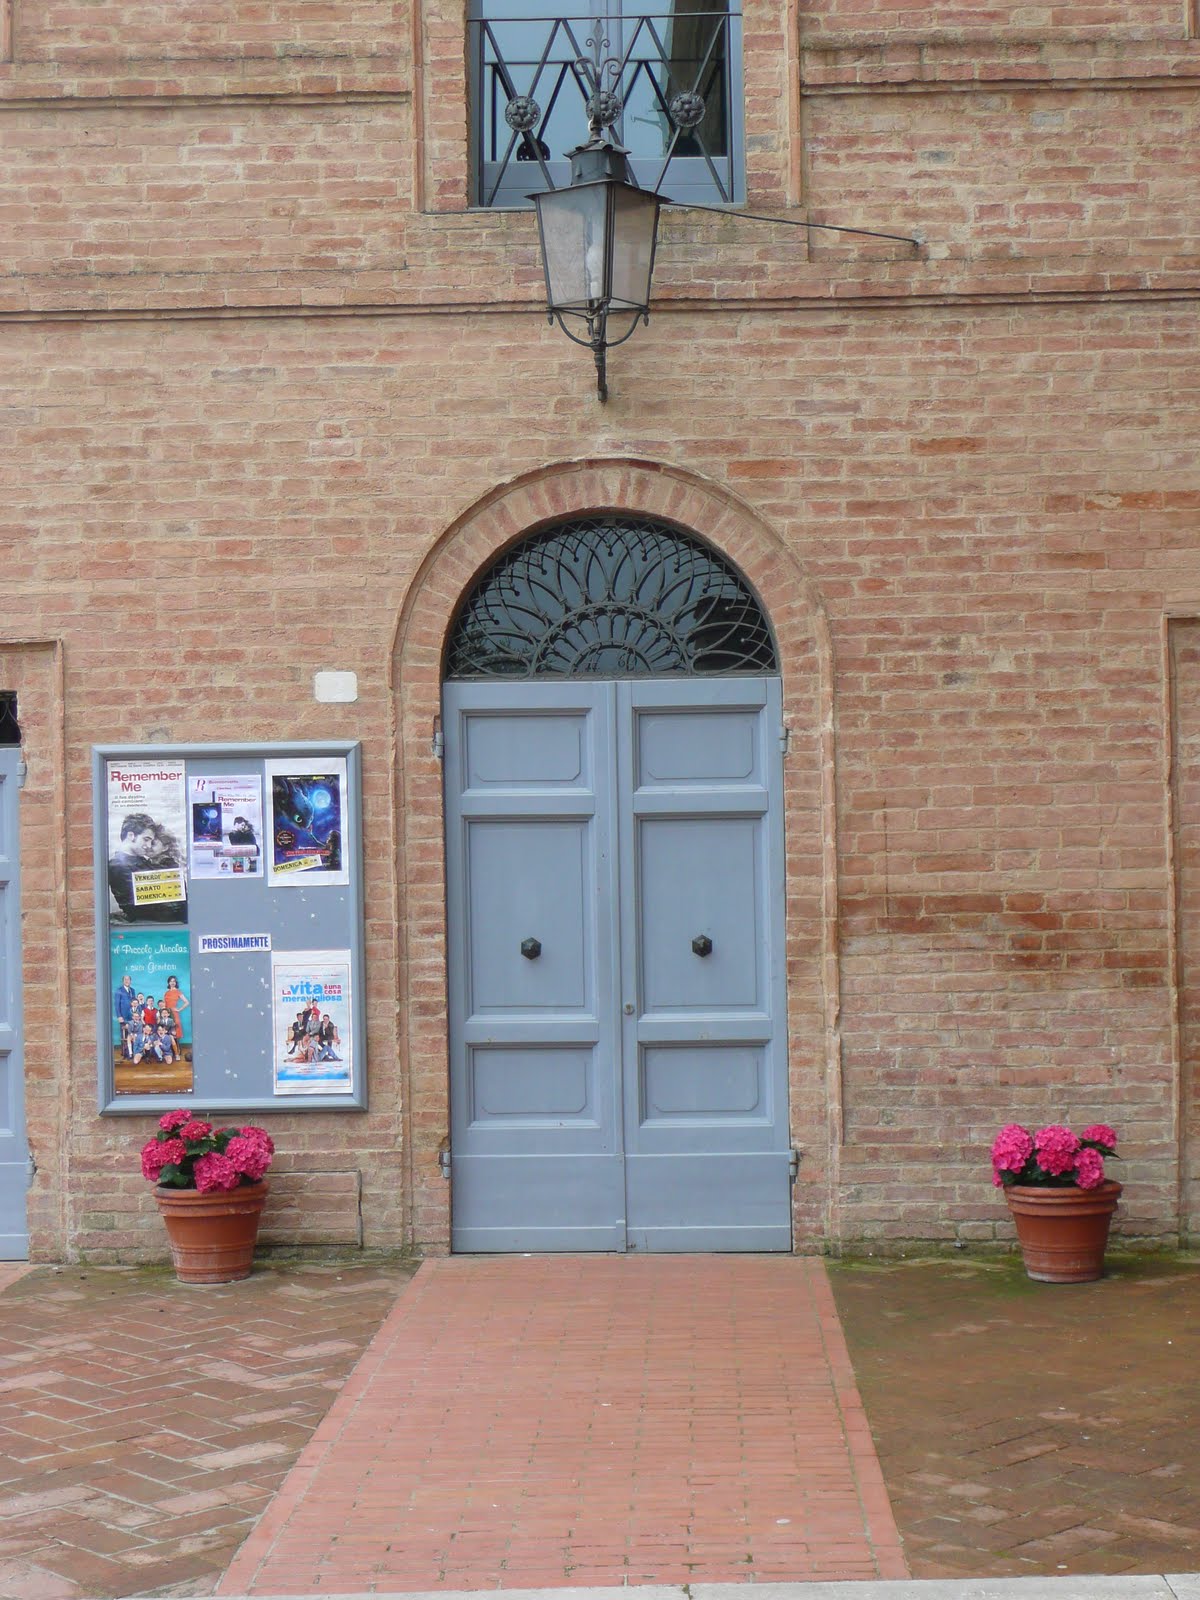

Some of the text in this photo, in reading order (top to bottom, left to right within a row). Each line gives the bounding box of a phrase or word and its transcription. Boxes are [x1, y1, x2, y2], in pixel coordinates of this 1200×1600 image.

[110, 771, 182, 782] Remember
[121, 782, 142, 792] Me
[273, 861, 302, 872] DOMENICA
[202, 936, 269, 949] PROSSIMAMENTE
[155, 943, 188, 954] Nicolas
[290, 981, 323, 995] vita
[282, 994, 342, 1002] meravigliosa
